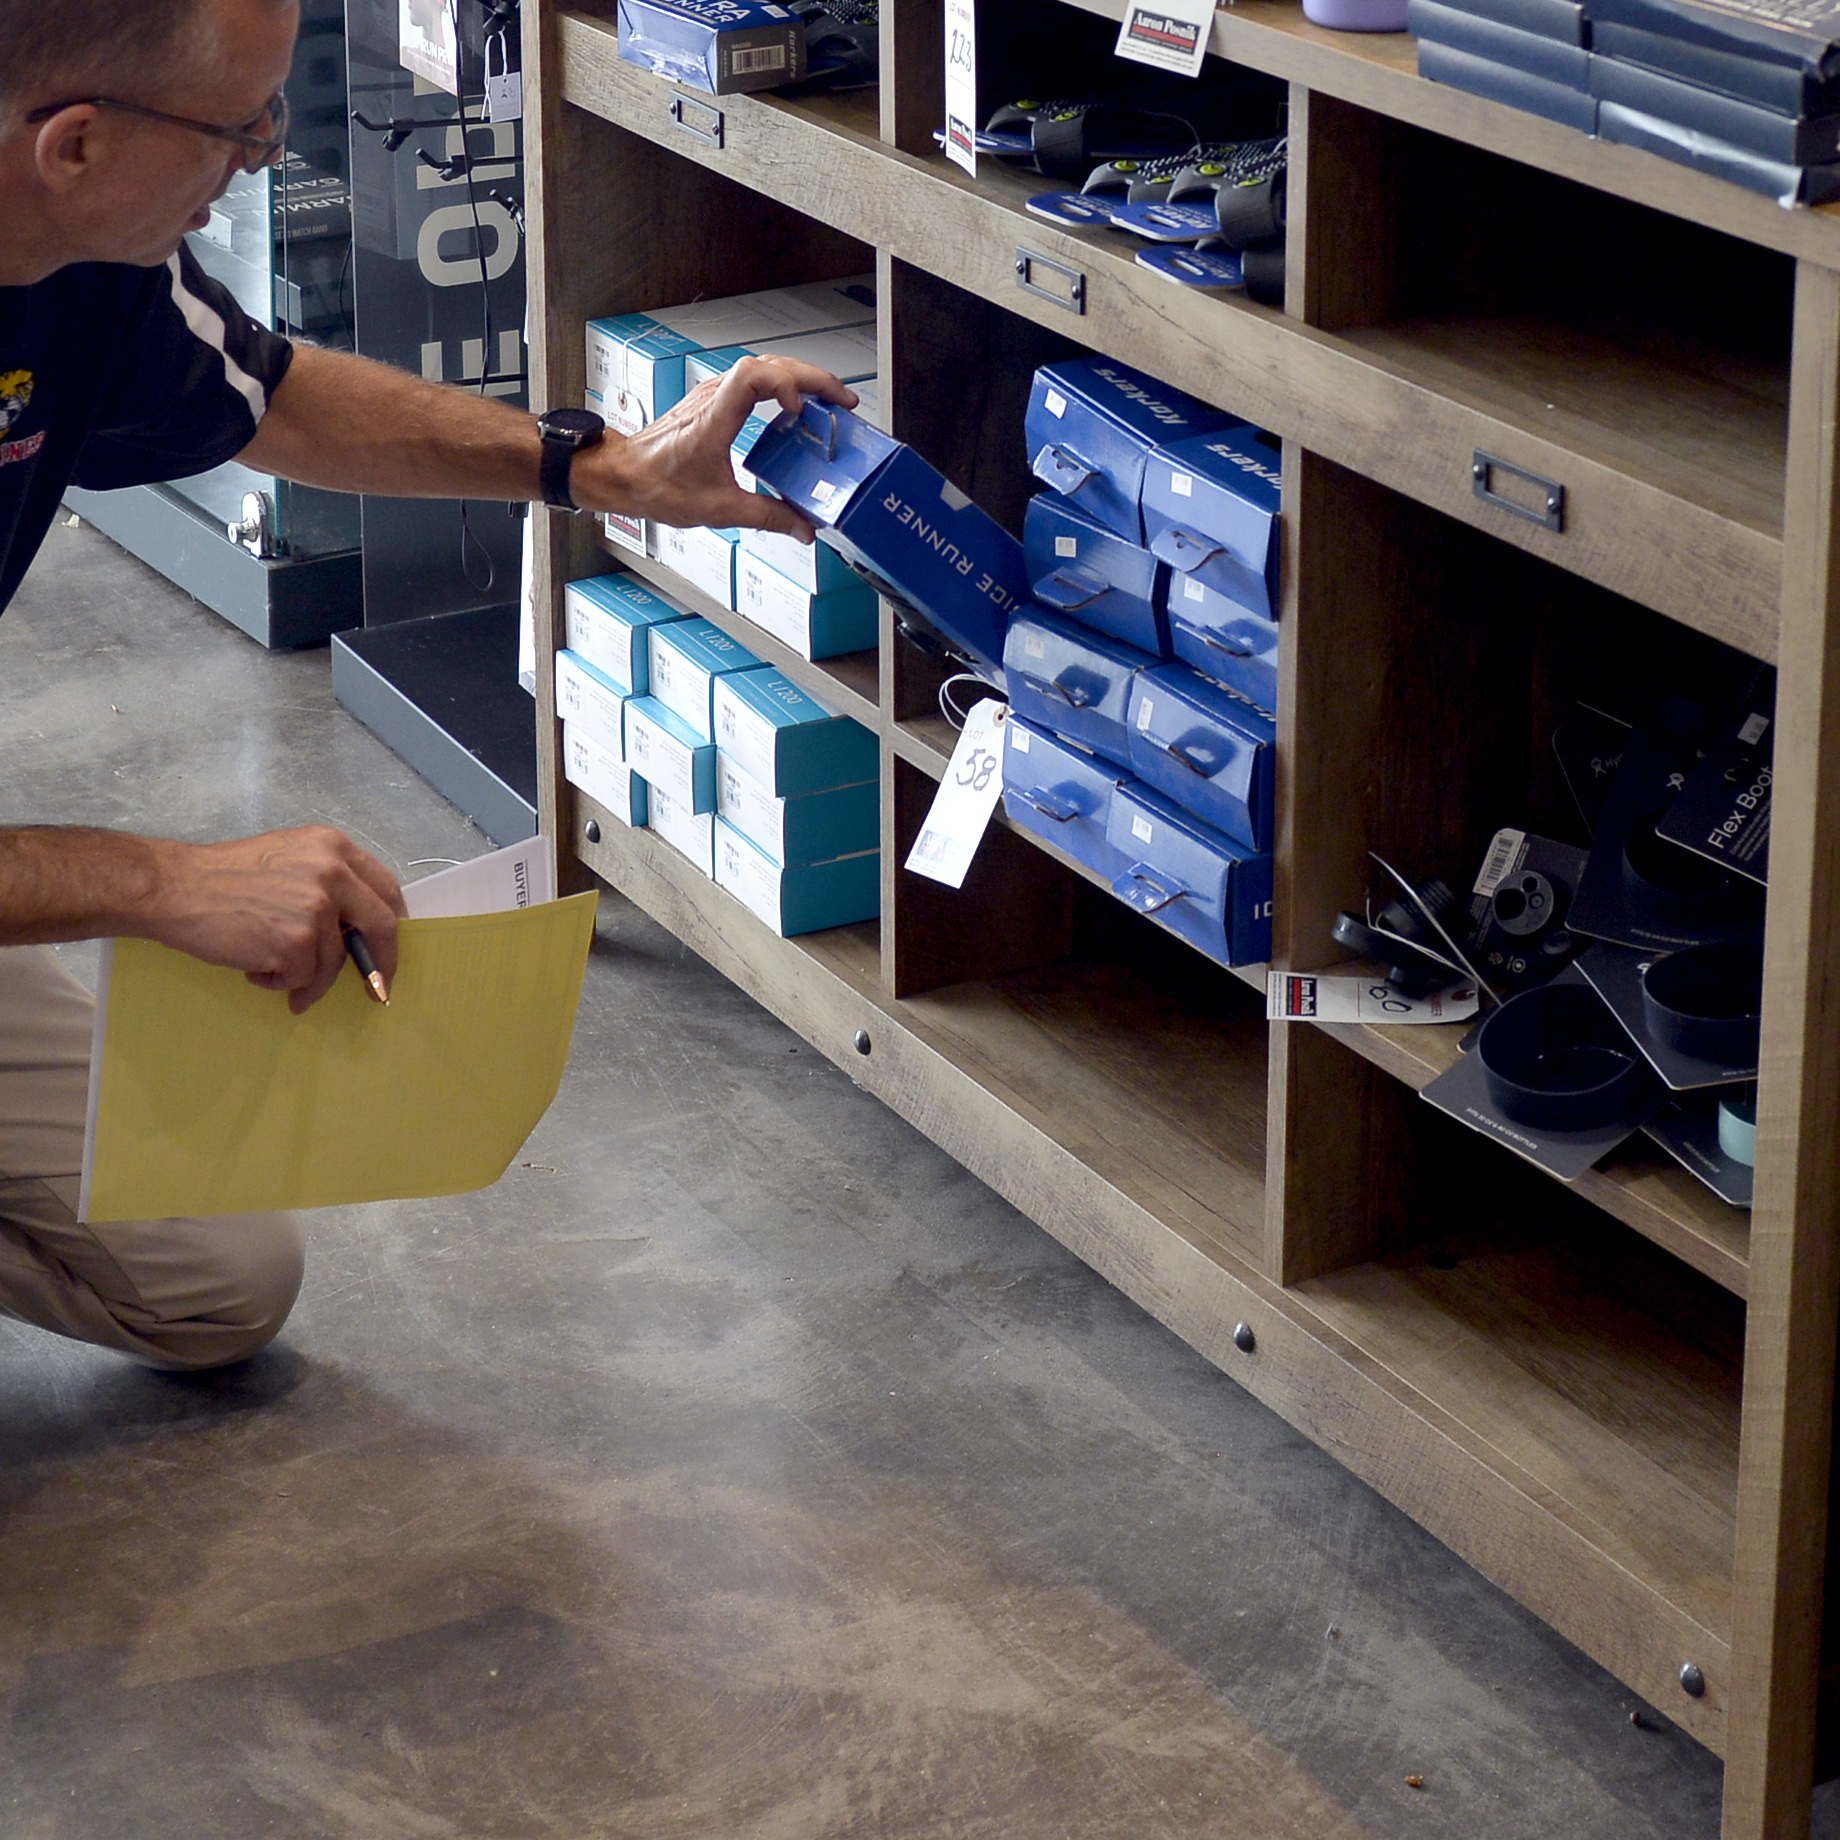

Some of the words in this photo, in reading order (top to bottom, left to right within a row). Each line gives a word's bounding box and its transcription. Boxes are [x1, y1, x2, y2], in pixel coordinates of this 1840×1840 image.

[1134, 12, 1166, 32] Aaron
[1166, 17, 1198, 39] Posnik
[1093, 367, 1190, 425] Korkers
[1207, 443, 1283, 491] orkers
[883, 491, 975, 577] RUNNER
[955, 747, 997, 792] 58
[1707, 803, 1747, 849] Flex
[1734, 765, 1774, 813] Boot
